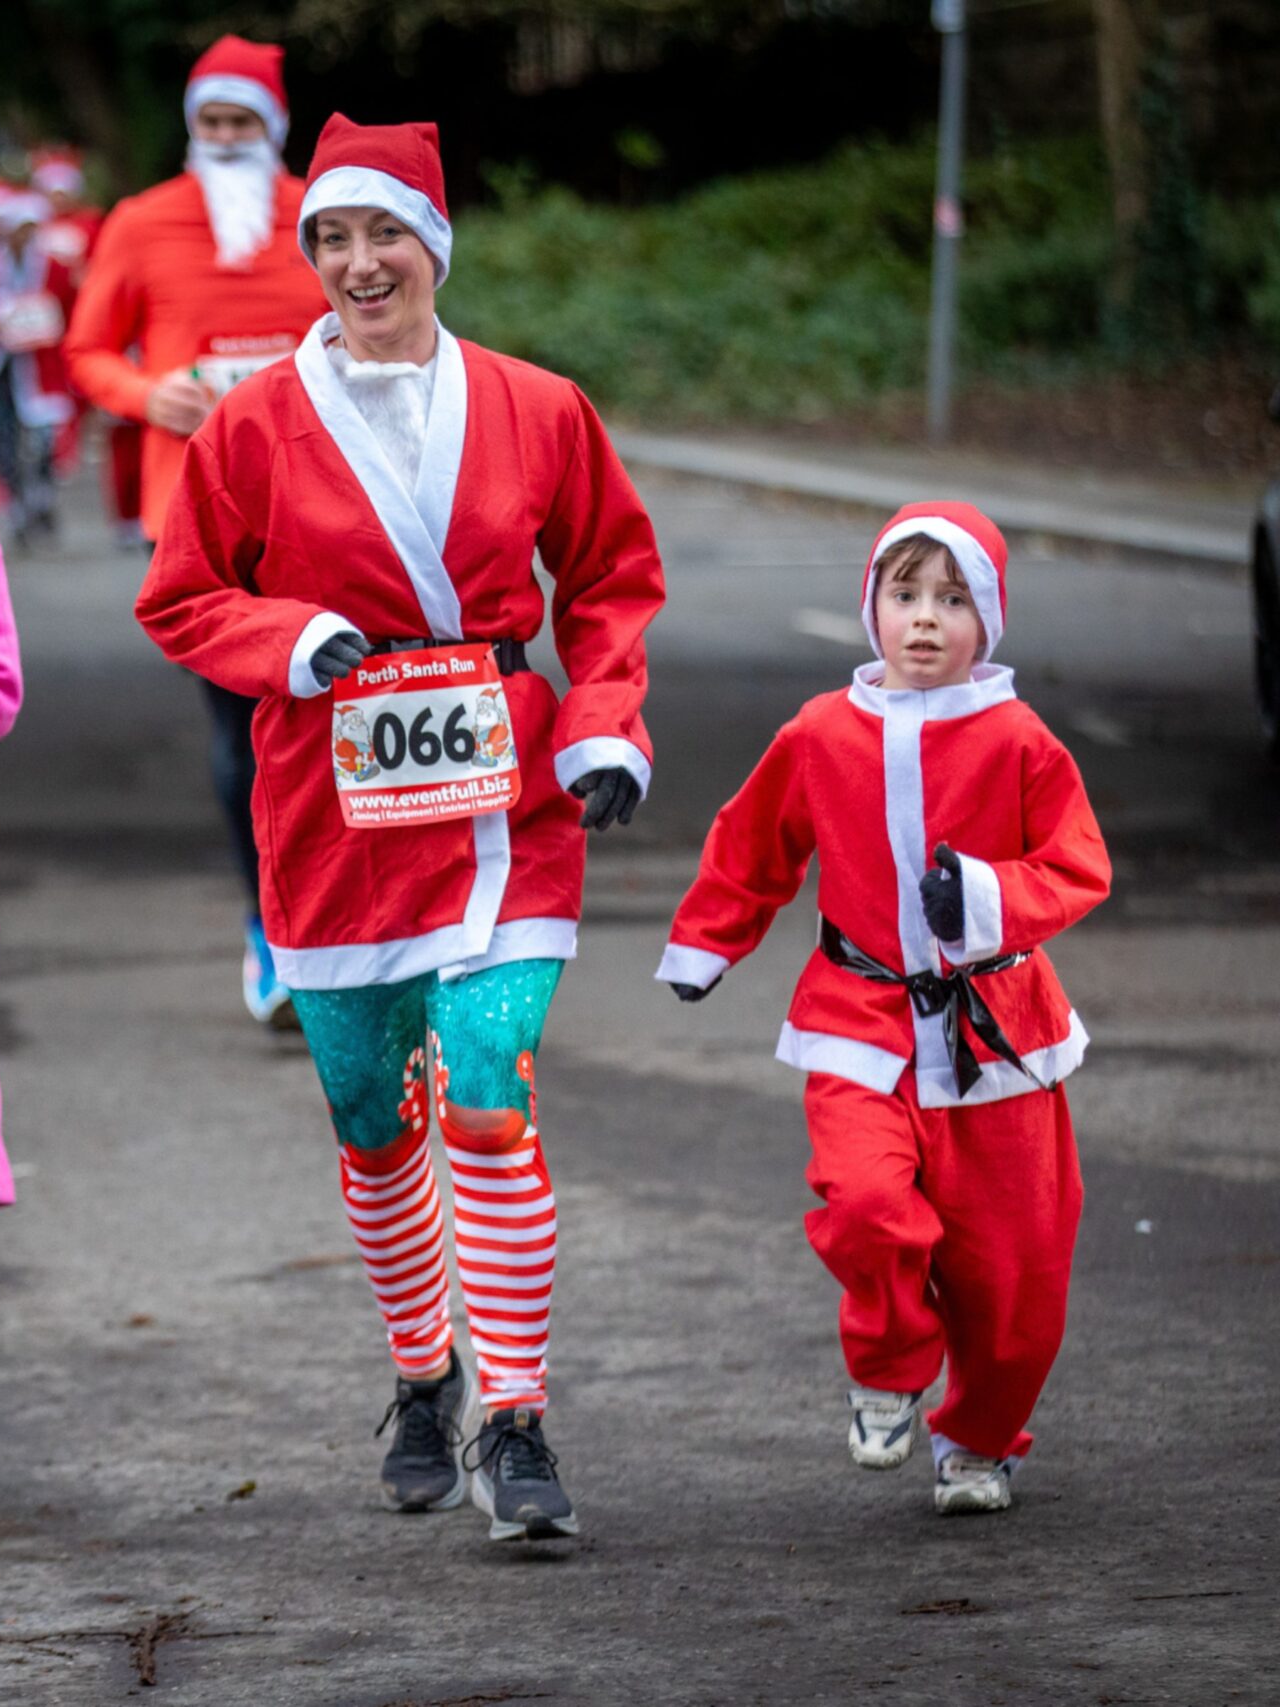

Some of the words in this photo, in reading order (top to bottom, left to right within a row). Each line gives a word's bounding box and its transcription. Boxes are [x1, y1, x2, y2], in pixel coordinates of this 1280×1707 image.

[357, 664, 398, 686] Perth
[402, 659, 448, 679] Santa
[451, 656, 475, 673] Run
[373, 703, 475, 770] 066
[349, 777, 510, 808] www.eventfull.biz
[386, 804, 434, 820] Equipment
[440, 801, 471, 814] Entries
